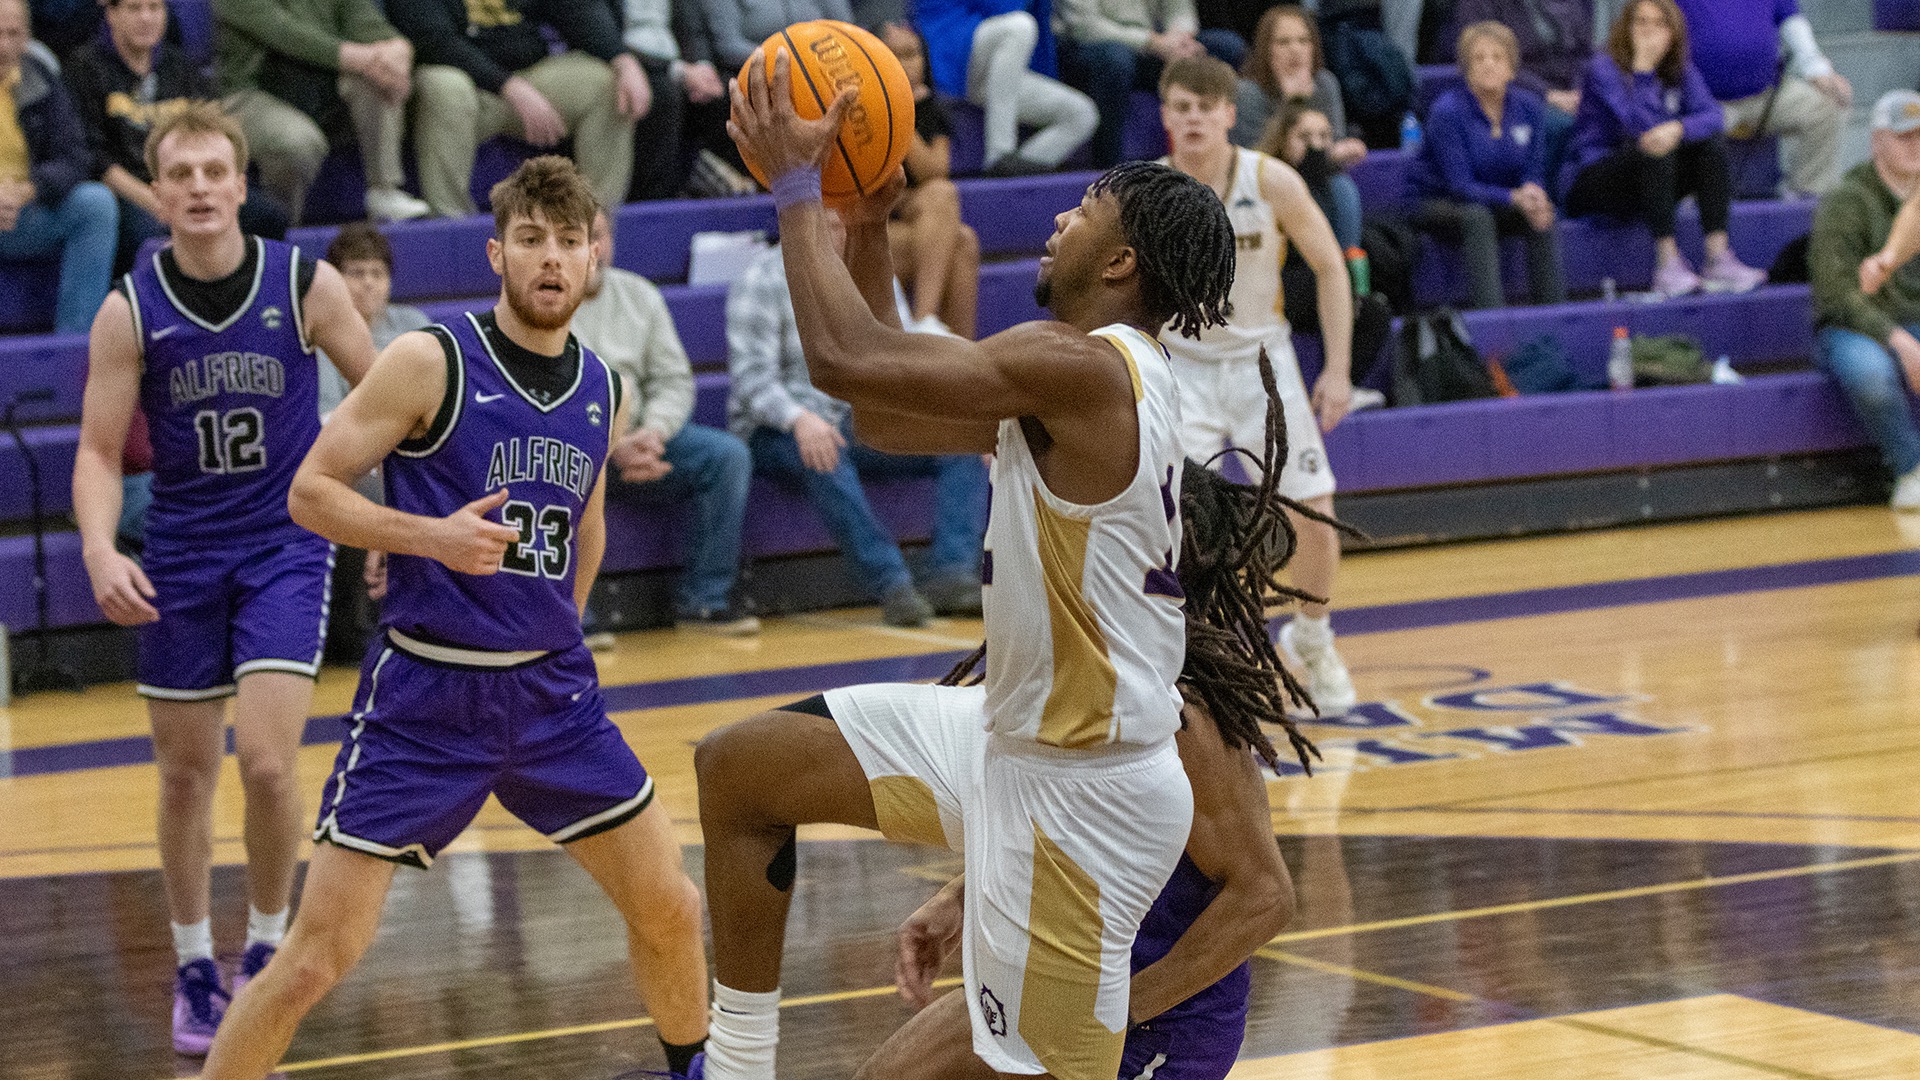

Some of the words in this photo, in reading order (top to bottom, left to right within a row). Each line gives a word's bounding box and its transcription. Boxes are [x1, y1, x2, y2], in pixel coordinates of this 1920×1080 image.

[810, 34, 873, 148] Wilon
[170, 351, 285, 406] ALFRED
[194, 406, 267, 474] 12
[485, 436, 594, 501] ALFRED
[499, 500, 573, 581] 23
